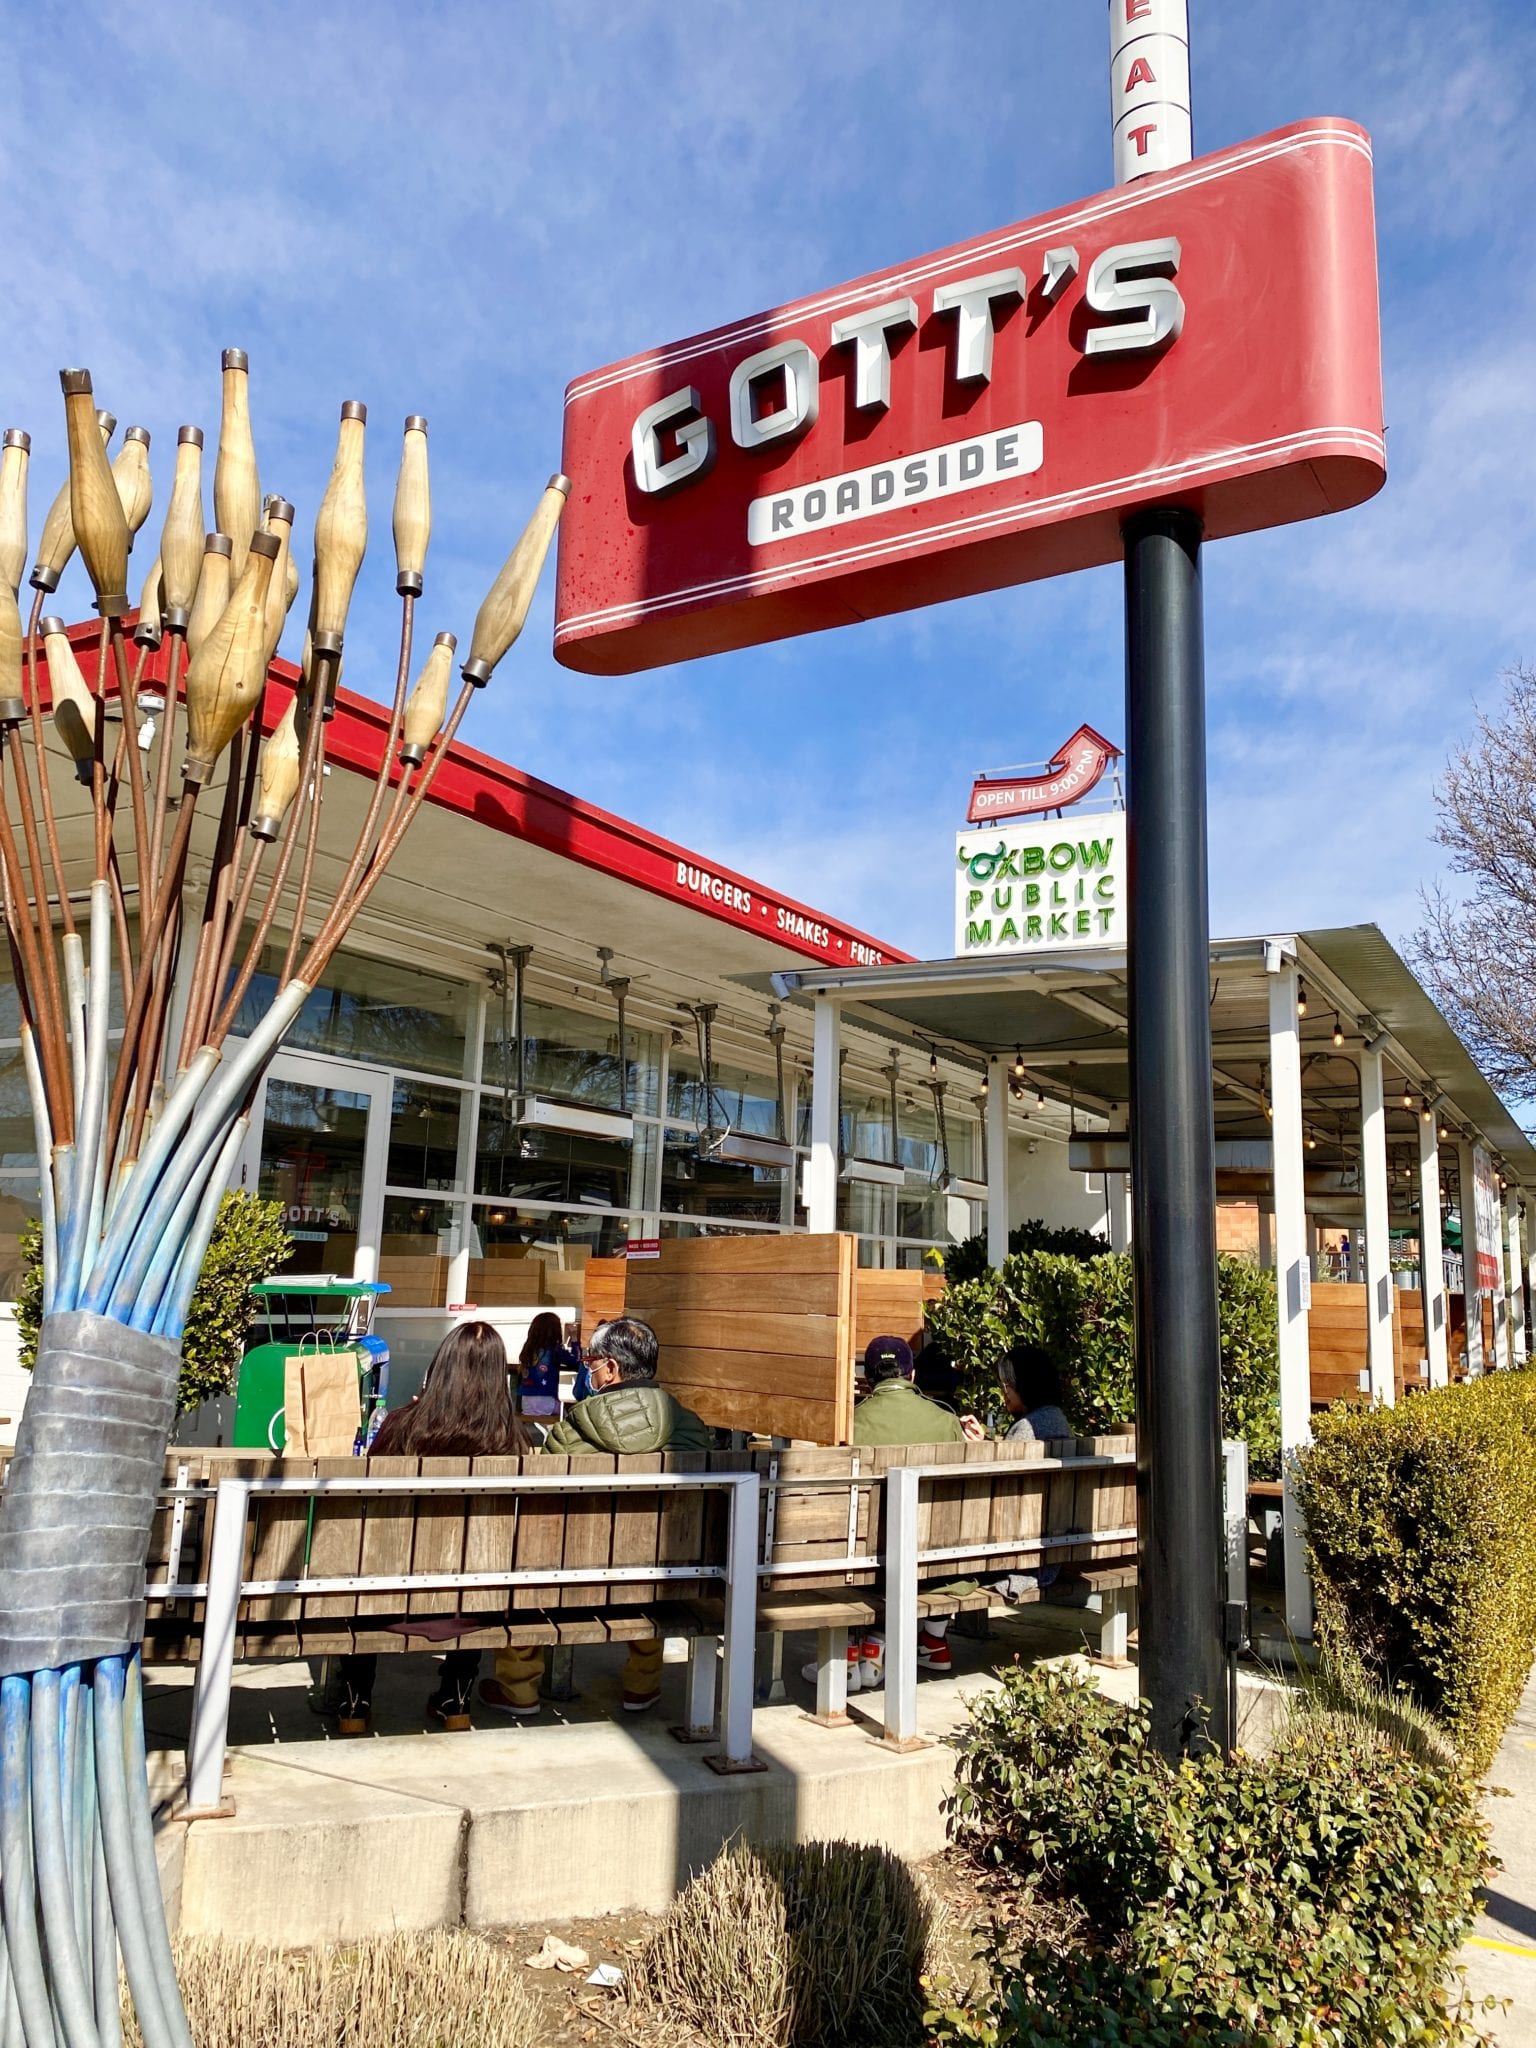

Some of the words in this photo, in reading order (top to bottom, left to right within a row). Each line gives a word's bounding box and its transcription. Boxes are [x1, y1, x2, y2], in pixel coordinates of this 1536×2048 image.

[631, 236, 1185, 494] GOTT'S
[772, 433, 1019, 533] ROADSIDE
[976, 791, 1015, 807] OPEN
[1019, 786, 1047, 802] TILL
[1050, 772, 1079, 796] 9:00
[1076, 749, 1094, 775] PM
[958, 838, 1114, 880] OXBOW
[677, 861, 751, 914] BURGERS
[777, 907, 829, 948] SHAKES
[850, 940, 882, 965] FRIES
[969, 875, 1115, 912] PUBLIC
[969, 908, 1115, 942] MARKET
[278, 1206, 340, 1227] GOTT'S
